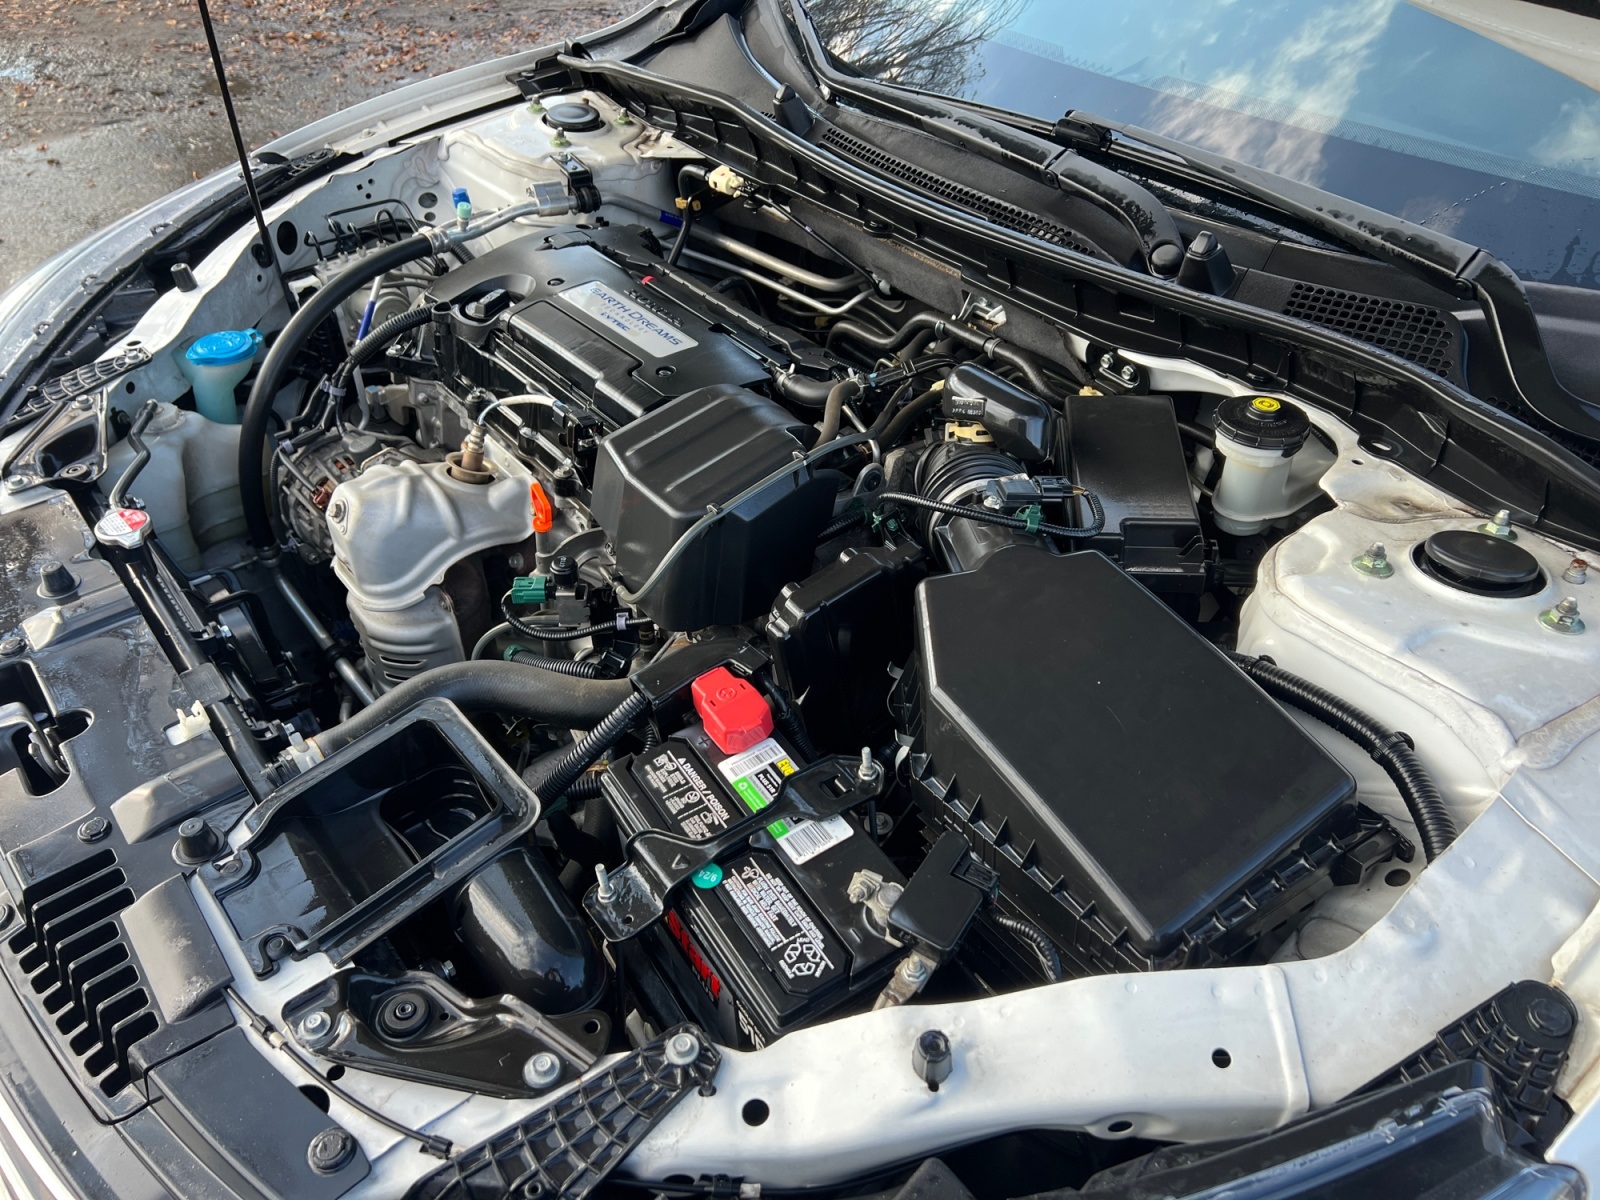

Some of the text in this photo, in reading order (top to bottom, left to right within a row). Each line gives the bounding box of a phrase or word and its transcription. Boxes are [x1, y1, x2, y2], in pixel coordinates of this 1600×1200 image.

[590, 287, 684, 346] EARTH DREAMS
[682, 762, 707, 791] DANGER
[705, 792, 730, 821] POISON
[757, 772, 770, 786] PLUS
[668, 910, 720, 1000] Start
